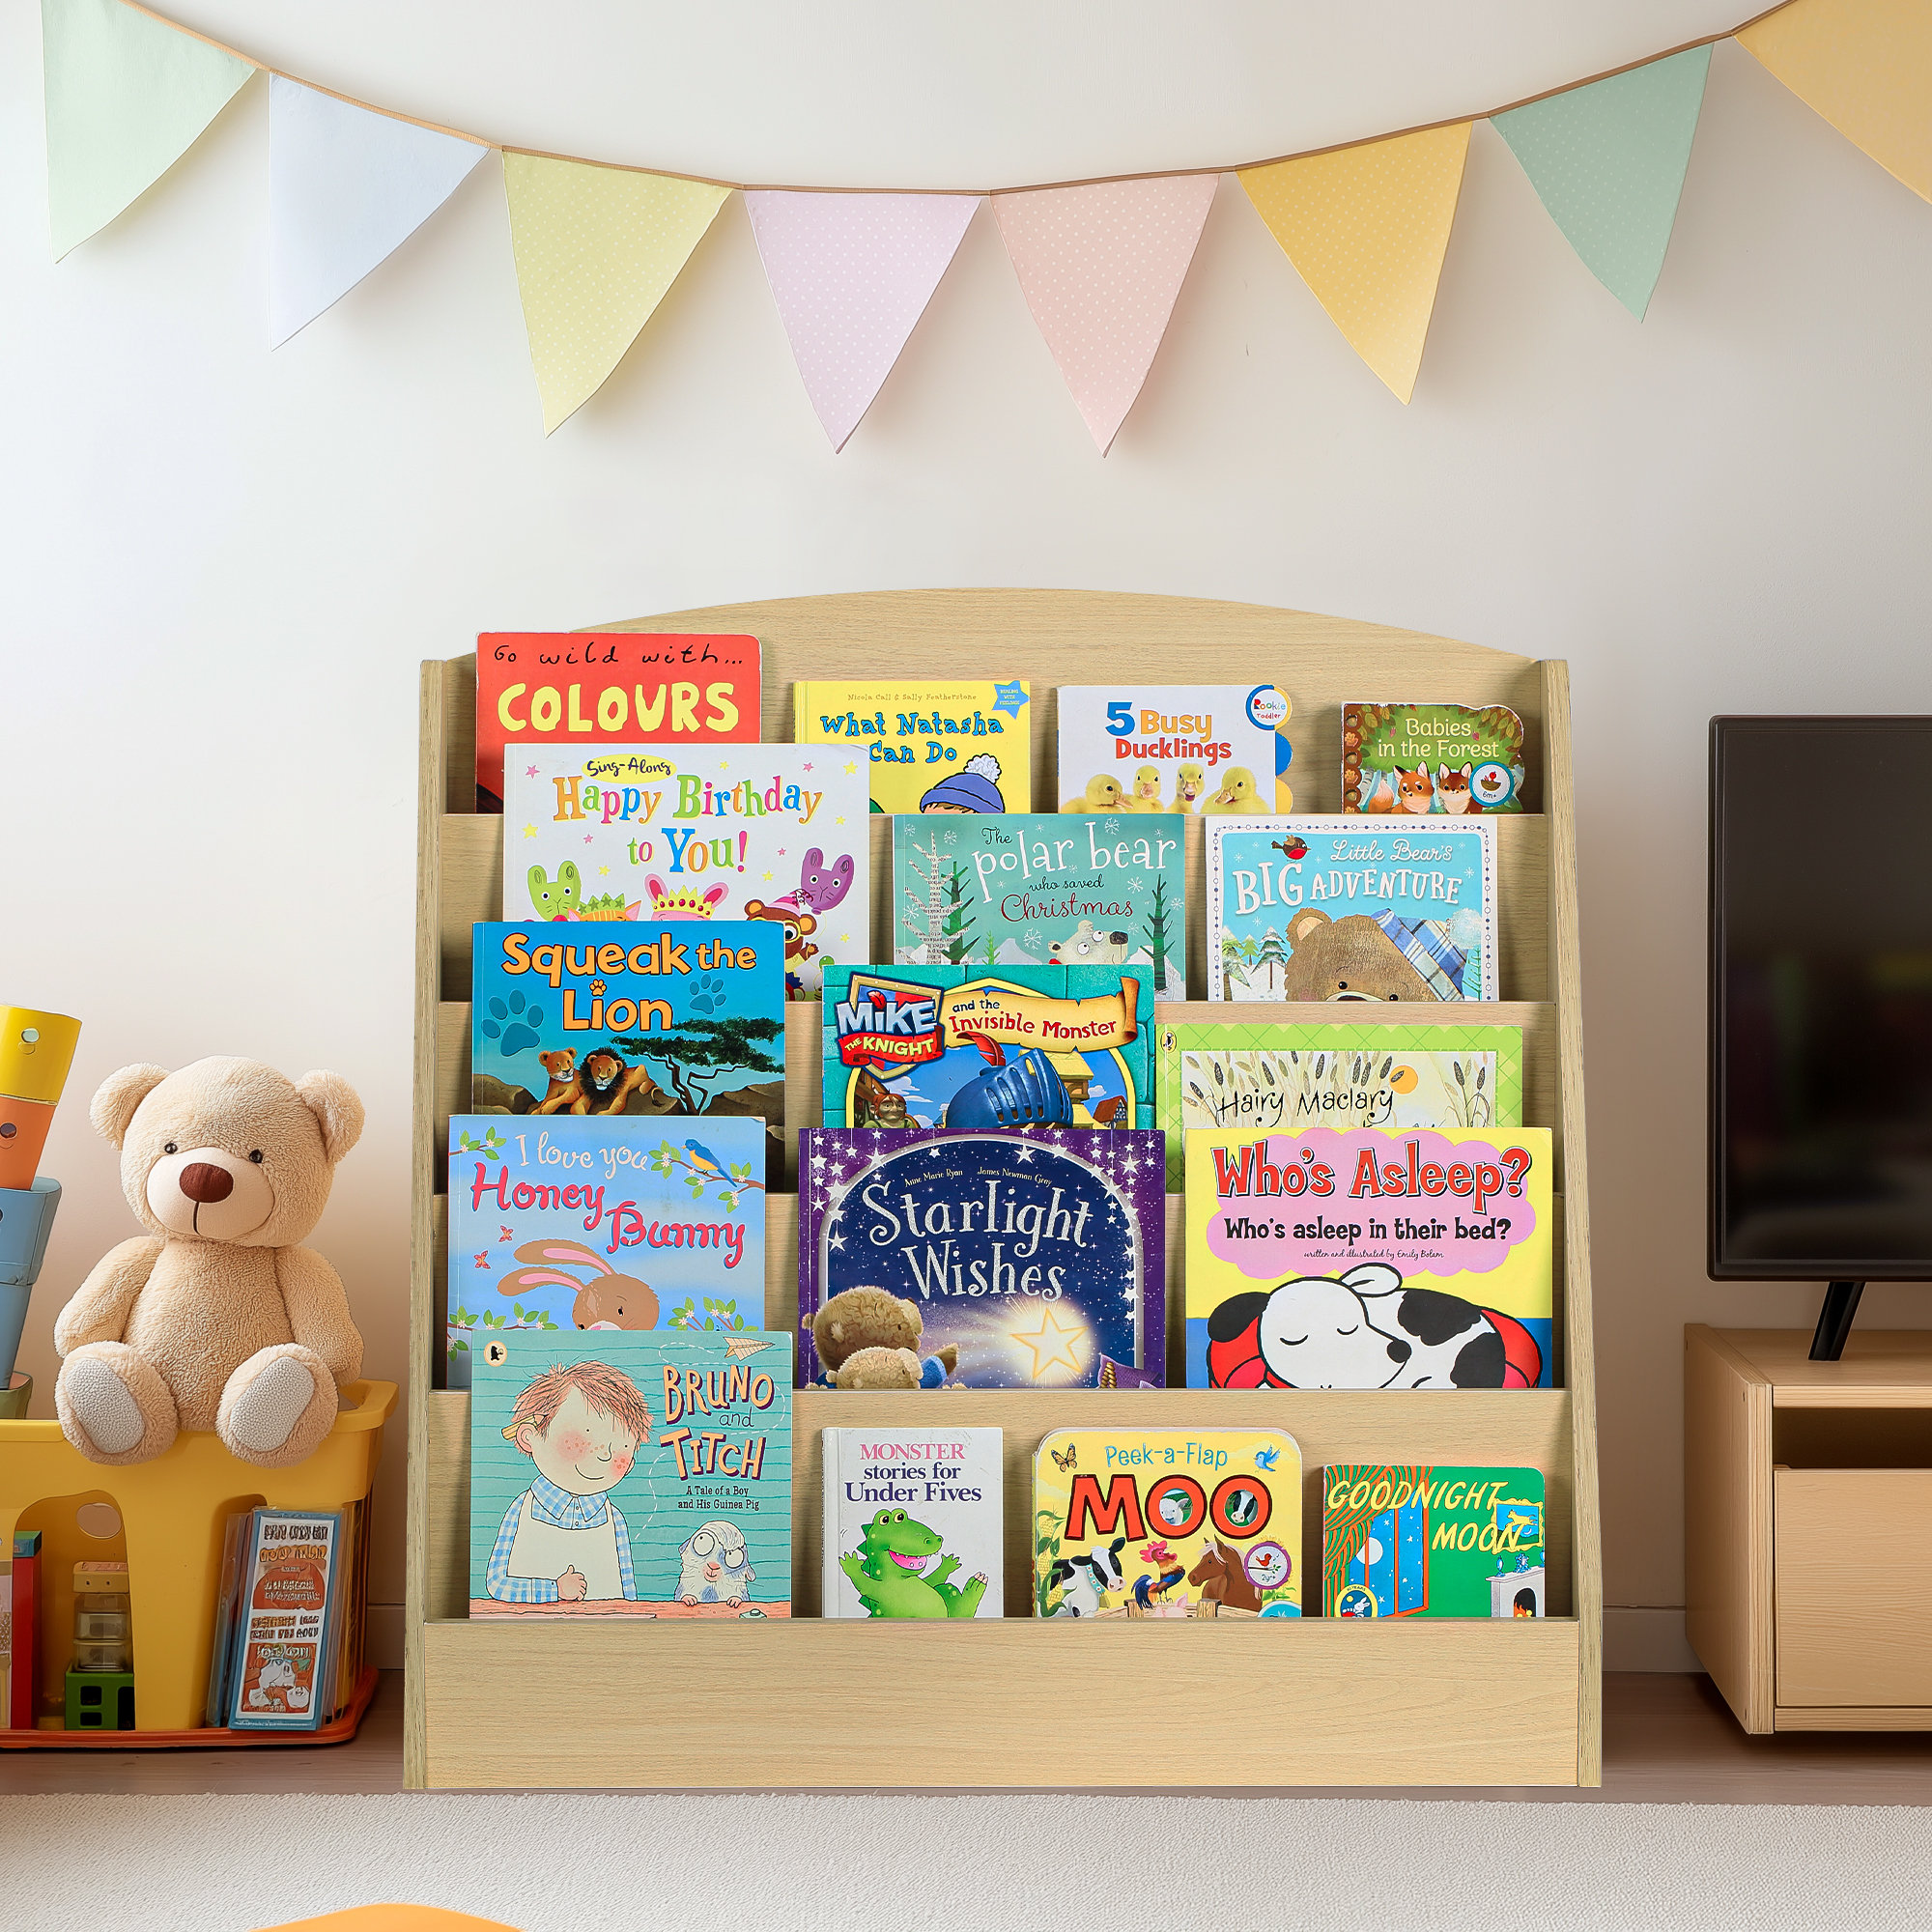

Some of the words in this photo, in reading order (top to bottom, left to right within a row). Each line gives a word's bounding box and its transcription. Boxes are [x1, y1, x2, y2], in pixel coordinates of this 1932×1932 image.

[494, 644, 517, 662] Go
[539, 641, 619, 665] wild
[641, 643, 743, 665] with...
[497, 681, 739, 733] COLOURS
[902, 694, 923, 703] Sally
[1254, 698, 1286, 710] Rookie
[820, 712, 886, 736] What
[896, 711, 1004, 736] Natasha
[1105, 701, 1136, 736] 5
[1140, 709, 1212, 743] Busy
[1406, 718, 1471, 737] Babies
[869, 740, 916, 763] Can
[925, 741, 957, 763] Do
[1116, 737, 1232, 766] Ducklings
[1378, 739, 1395, 757] in
[1401, 738, 1431, 757] the
[1436, 739, 1499, 757] Forest
[587, 757, 671, 777] Sing-Along
[553, 775, 662, 824] Happy
[672, 774, 823, 824] Birthday
[627, 838, 653, 865] to
[662, 827, 750, 873] You!
[981, 827, 1013, 845] The
[1330, 839, 1385, 862] Little
[1390, 838, 1453, 861] Bear's
[971, 830, 1074, 904] polar
[1085, 821, 1177, 870] bear
[1029, 876, 1060, 892] who
[1062, 873, 1105, 890] saved
[1233, 861, 1304, 915] BIG
[1309, 868, 1463, 904] ADVENTURE
[1001, 893, 1134, 923] Christmas
[501, 932, 692, 988] Squeak
[696, 938, 757, 970] the
[562, 979, 674, 1032] Lion
[952, 1000, 976, 1012] and
[980, 999, 1001, 1009] the
[949, 1010, 1036, 1033] Invisible
[1042, 1020, 1117, 1038] Monster
[844, 1037, 863, 1051] THE
[863, 1036, 934, 1056] KNIGHT
[1217, 1089, 1284, 1127] Hairy
[1297, 1088, 1394, 1123] Maclary
[515, 1134, 530, 1166] I
[538, 1131, 594, 1169] love
[598, 1147, 648, 1179] you
[904, 1178, 923, 1188] Anne
[923, 1171, 945, 1182] Marie
[947, 1168, 963, 1179] Ryan
[977, 1166, 1000, 1176] James
[1002, 1168, 1033, 1181] Newman
[1210, 1139, 1336, 1198] Who's
[1348, 1139, 1533, 1214] Asleep?
[470, 1162, 605, 1231] Honey
[862, 1179, 1094, 1258] Starlight
[1224, 1217, 1286, 1240] Who's
[1293, 1215, 1362, 1246] asleep
[1369, 1217, 1387, 1239] in
[1394, 1217, 1448, 1240] their
[1455, 1216, 1512, 1240] bed?
[605, 1200, 746, 1269] Bunny
[1304, 1249, 1330, 1258] written
[1331, 1249, 1346, 1258] and
[1347, 1248, 1385, 1258] illustrated
[1386, 1248, 1395, 1261] by
[1397, 1249, 1419, 1261] Emily
[1420, 1249, 1445, 1258] Bolam
[901, 1239, 1067, 1302] Wishes
[663, 1365, 775, 1425] BRUNO
[720, 1407, 754, 1428] and
[659, 1427, 766, 1481] TITCH
[860, 1443, 966, 1461] MONSTER
[1105, 1442, 1229, 1471] Peek-a-Flap
[864, 1462, 926, 1480] stories
[932, 1462, 961, 1480] for
[678, 1499, 695, 1509] and
[696, 1499, 711, 1509] His
[714, 1499, 744, 1509] Guinea
[746, 1499, 760, 1511] Pig
[686, 1486, 693, 1495] A
[695, 1486, 713, 1495] Tale
[715, 1486, 724, 1495] of
[733, 1486, 750, 1497] Boy
[844, 1482, 919, 1502] Under
[924, 1482, 982, 1502] Fives
[1327, 1480, 1509, 1510] GOODNIGHT
[1064, 1474, 1273, 1542] MOO
[1432, 1522, 1524, 1552] MOON
